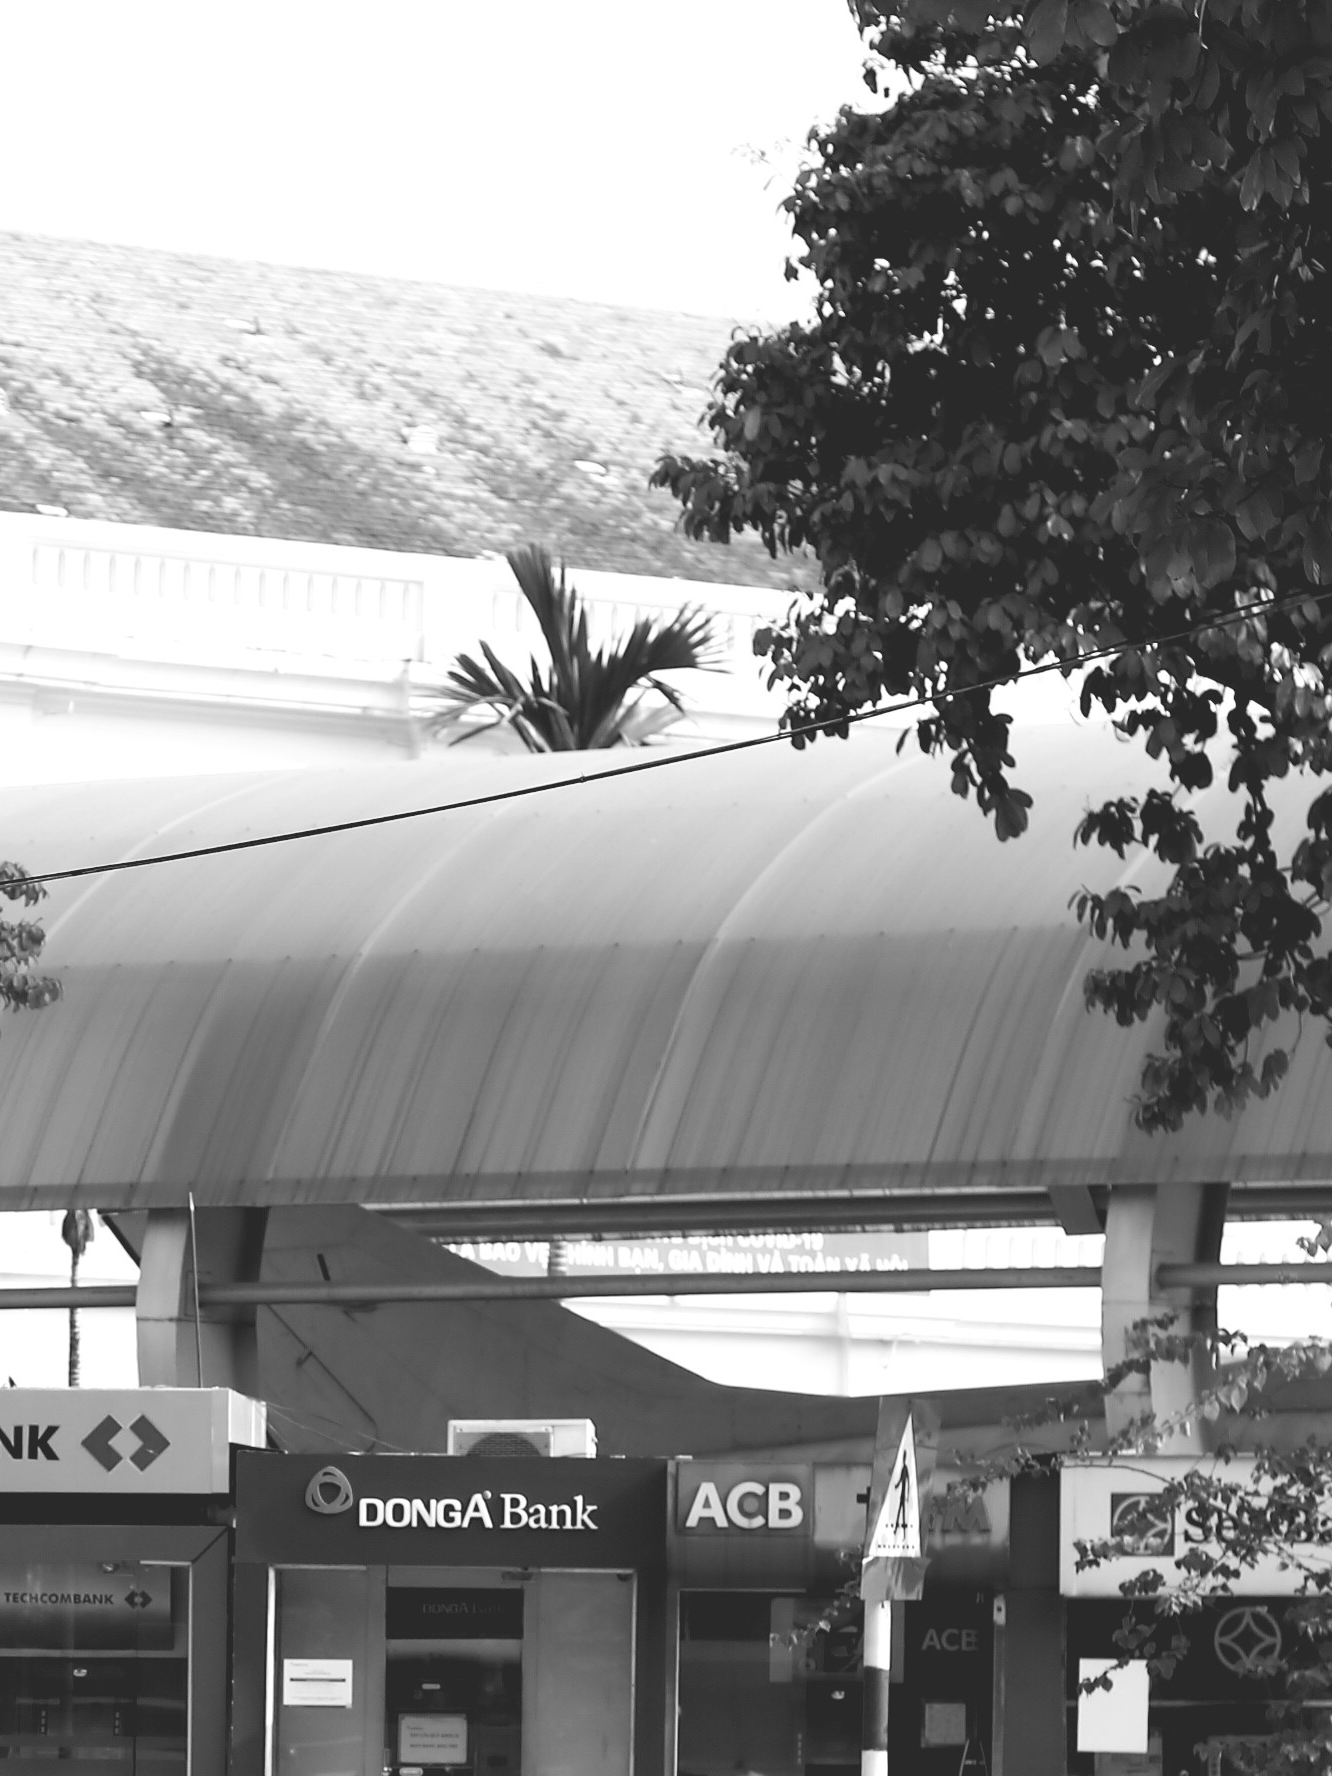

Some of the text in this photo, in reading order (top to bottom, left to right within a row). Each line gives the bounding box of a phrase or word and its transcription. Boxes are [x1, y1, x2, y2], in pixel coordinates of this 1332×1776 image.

[500, 1493, 599, 1530] Bank
[685, 1481, 804, 1530] ACB
[4, 1592, 114, 1605] TECHCOMBANK
